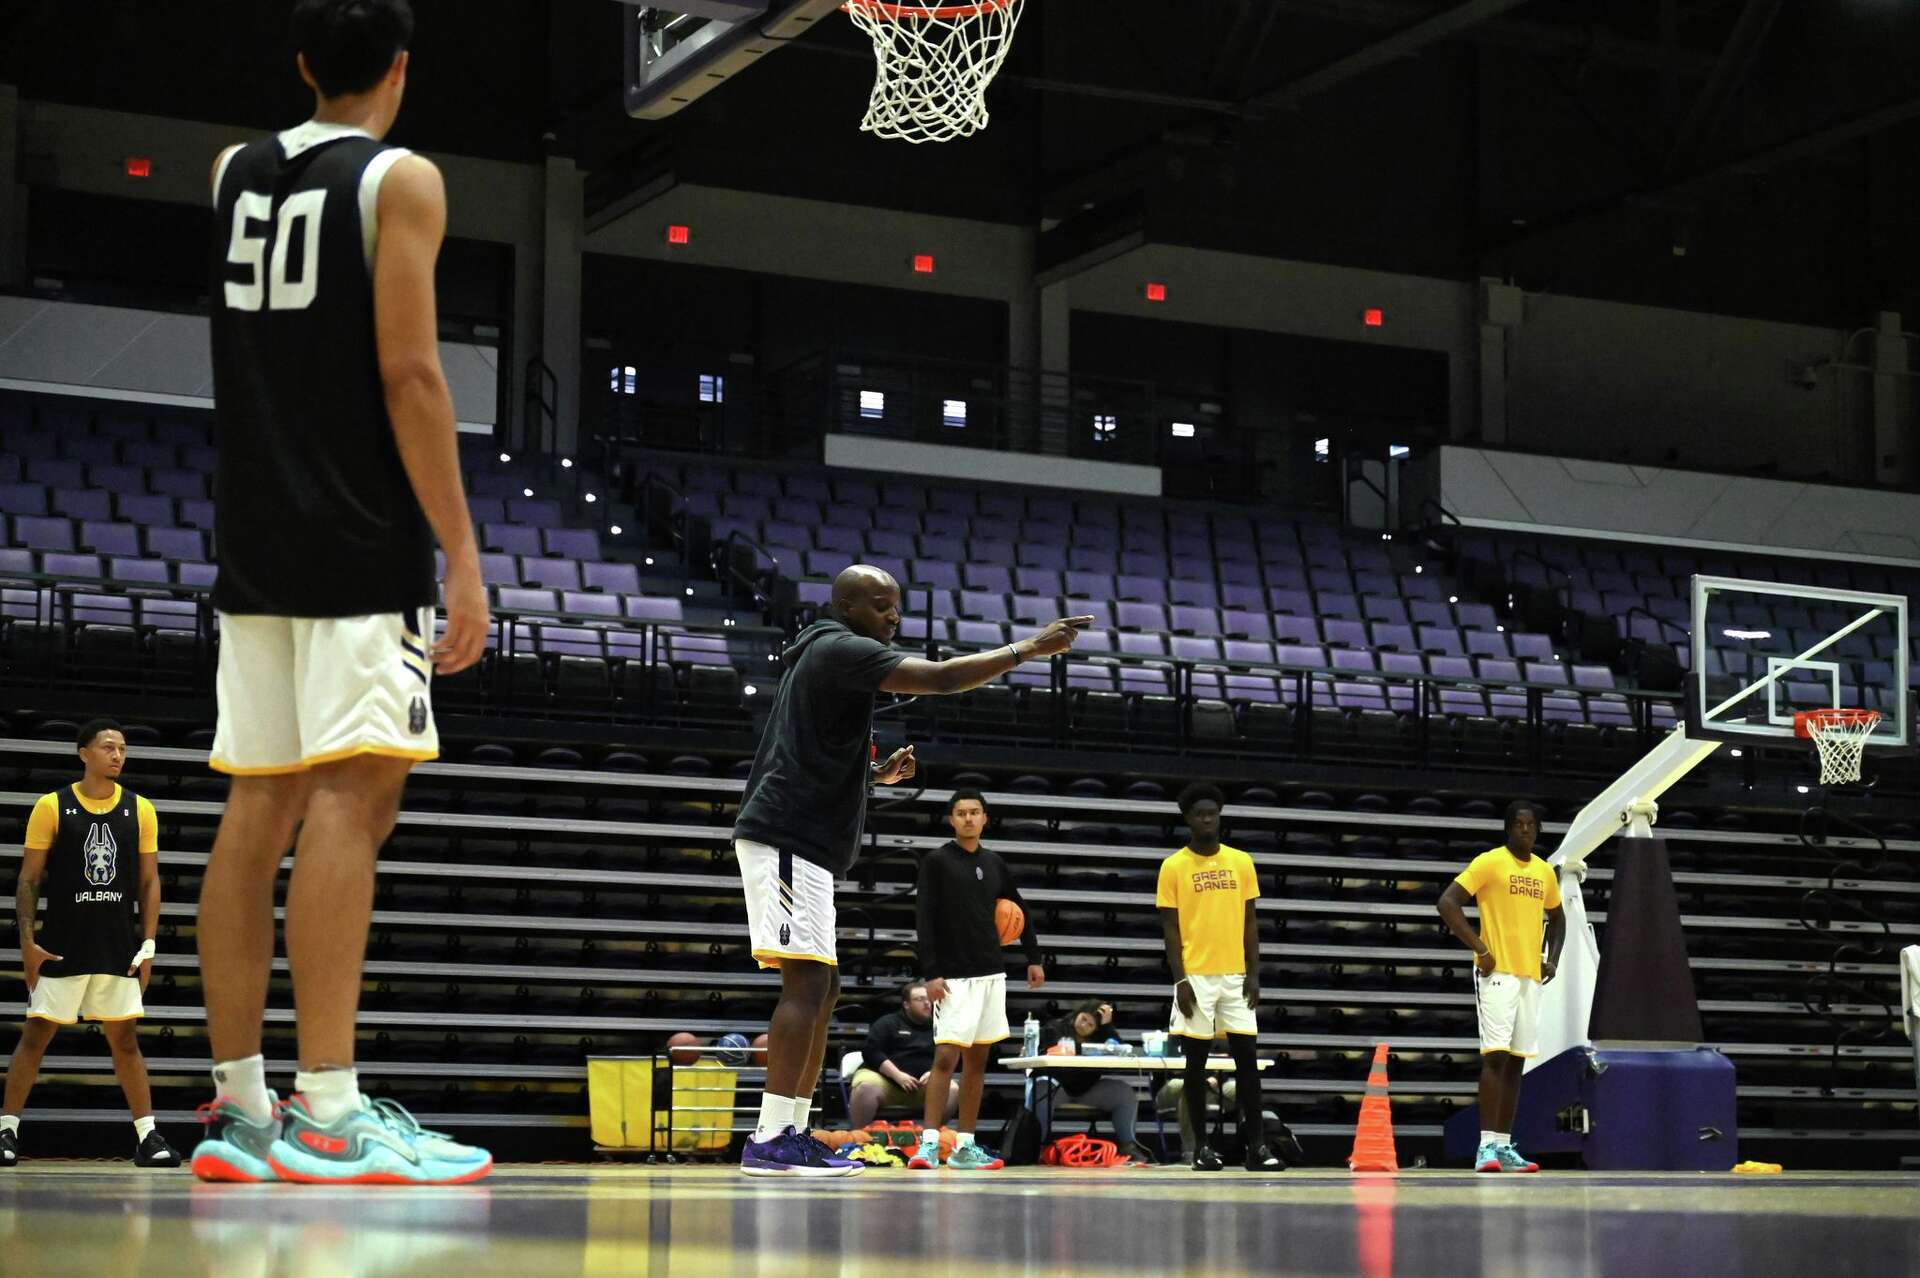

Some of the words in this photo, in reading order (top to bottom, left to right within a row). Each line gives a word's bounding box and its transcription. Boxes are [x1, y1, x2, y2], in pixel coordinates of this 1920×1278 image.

[224, 188, 328, 311] 50
[1192, 869, 1233, 882] GREAT
[1509, 874, 1544, 888] GREAT
[1194, 879, 1237, 893] DANES
[1509, 884, 1544, 900] DANES
[75, 891, 122, 903] UALBANY
